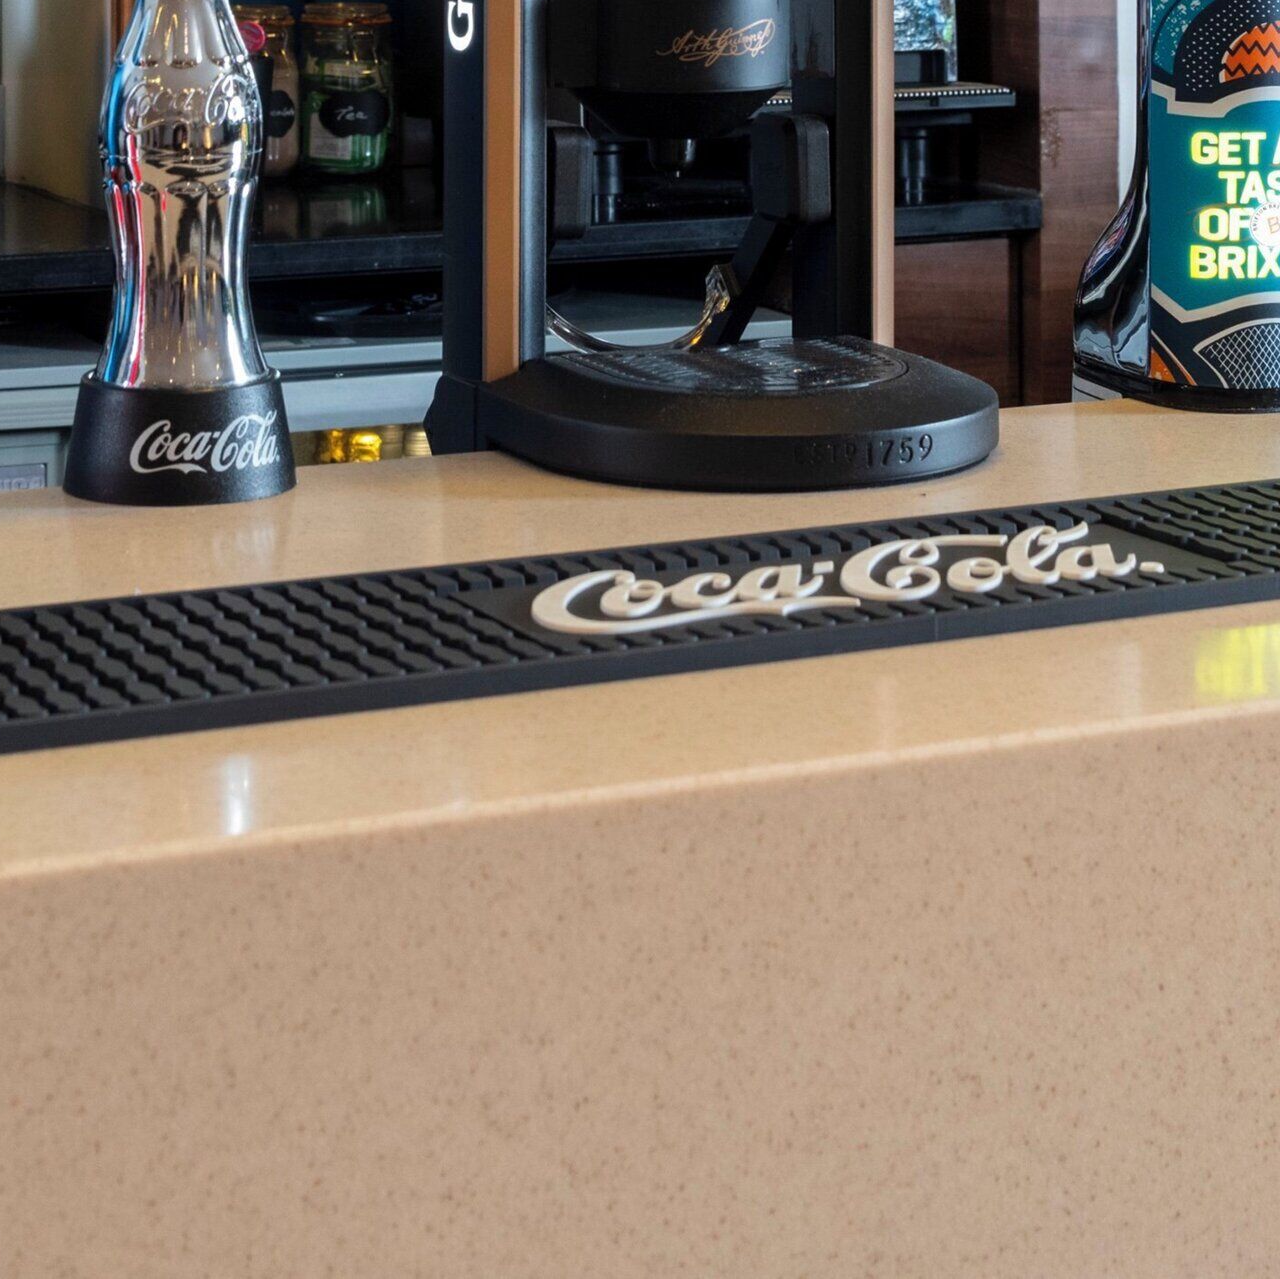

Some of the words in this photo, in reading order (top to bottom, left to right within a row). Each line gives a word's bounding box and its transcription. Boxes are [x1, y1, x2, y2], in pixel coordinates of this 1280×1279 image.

[1190, 131, 1267, 166] GET
[1198, 207, 1255, 242] OF
[129, 410, 278, 474] Coca-Cola
[864, 433, 935, 470] 1759
[531, 521, 1145, 634] Coca-Cola
